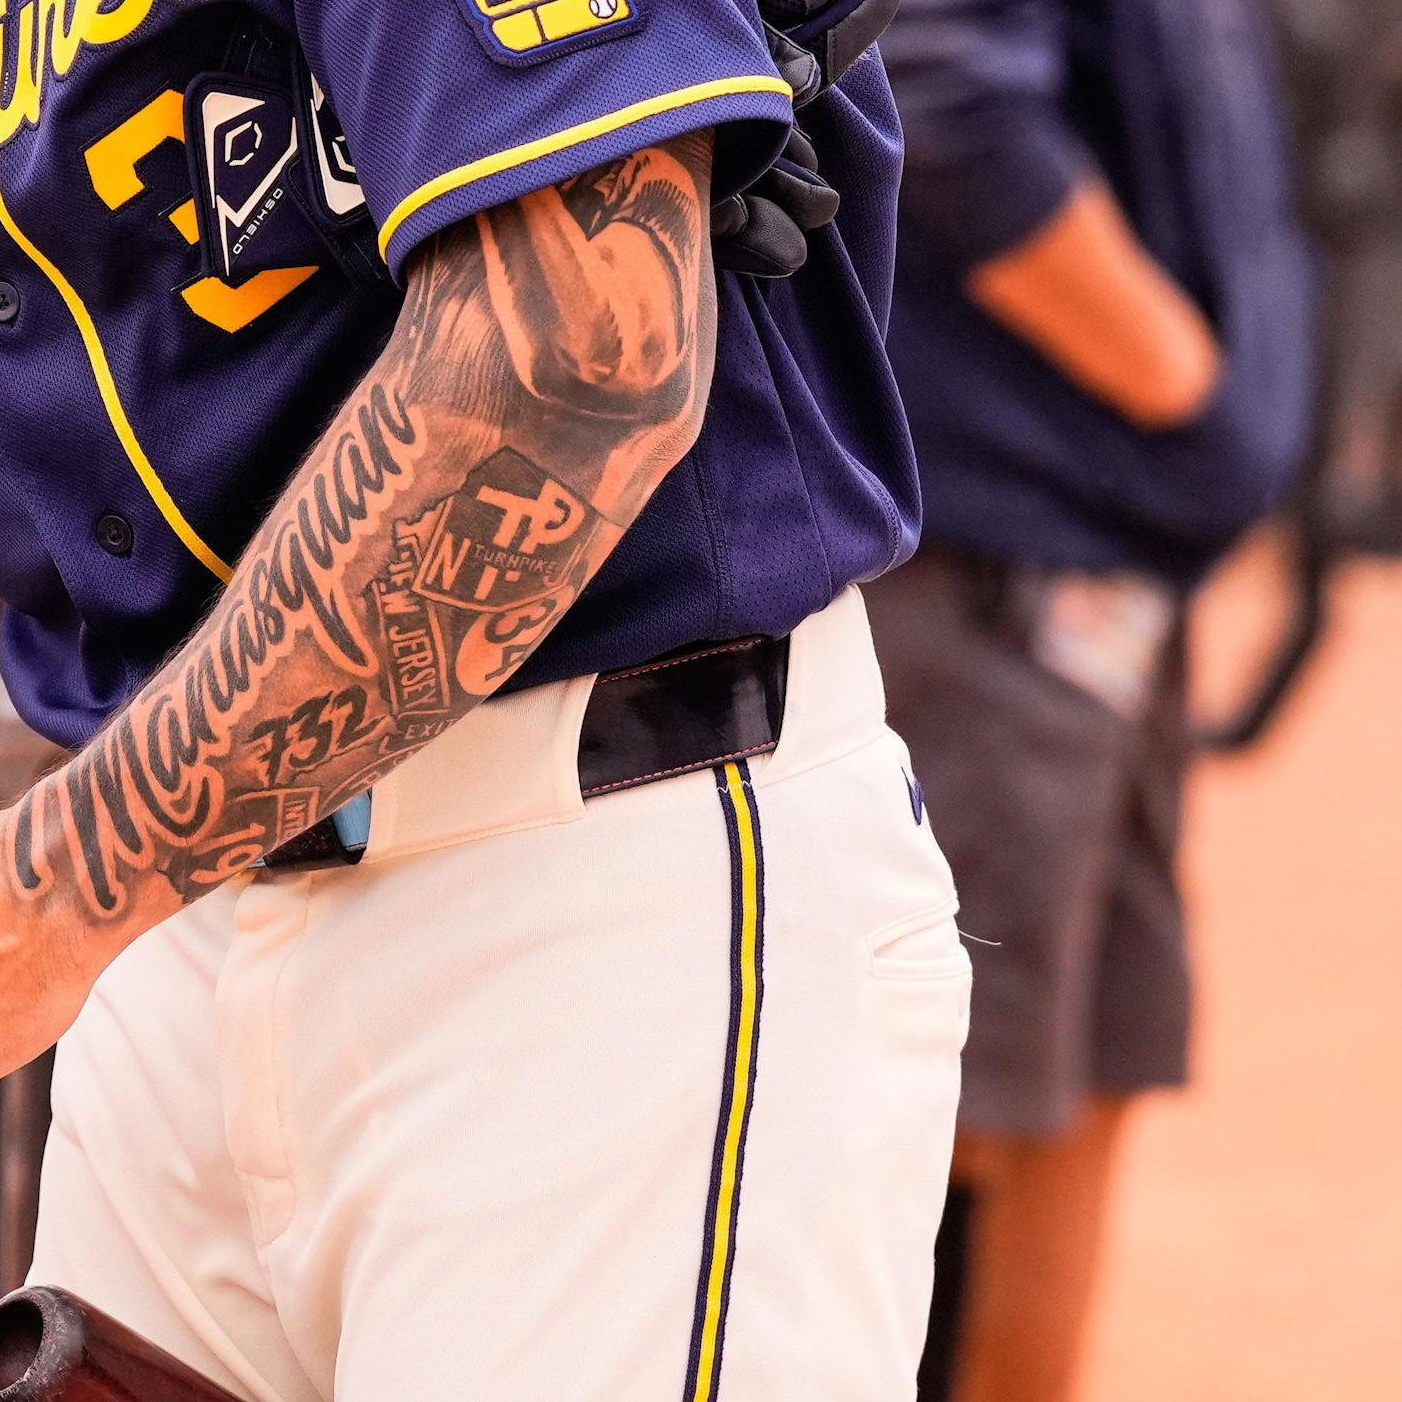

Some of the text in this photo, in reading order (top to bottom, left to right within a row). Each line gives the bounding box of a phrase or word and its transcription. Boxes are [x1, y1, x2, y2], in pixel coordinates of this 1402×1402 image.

[473, 544, 558, 576] TURNPIKE
[14, 383, 416, 911] Manasquan
[388, 625, 437, 708] JERSEY
[243, 684, 387, 791] 732
